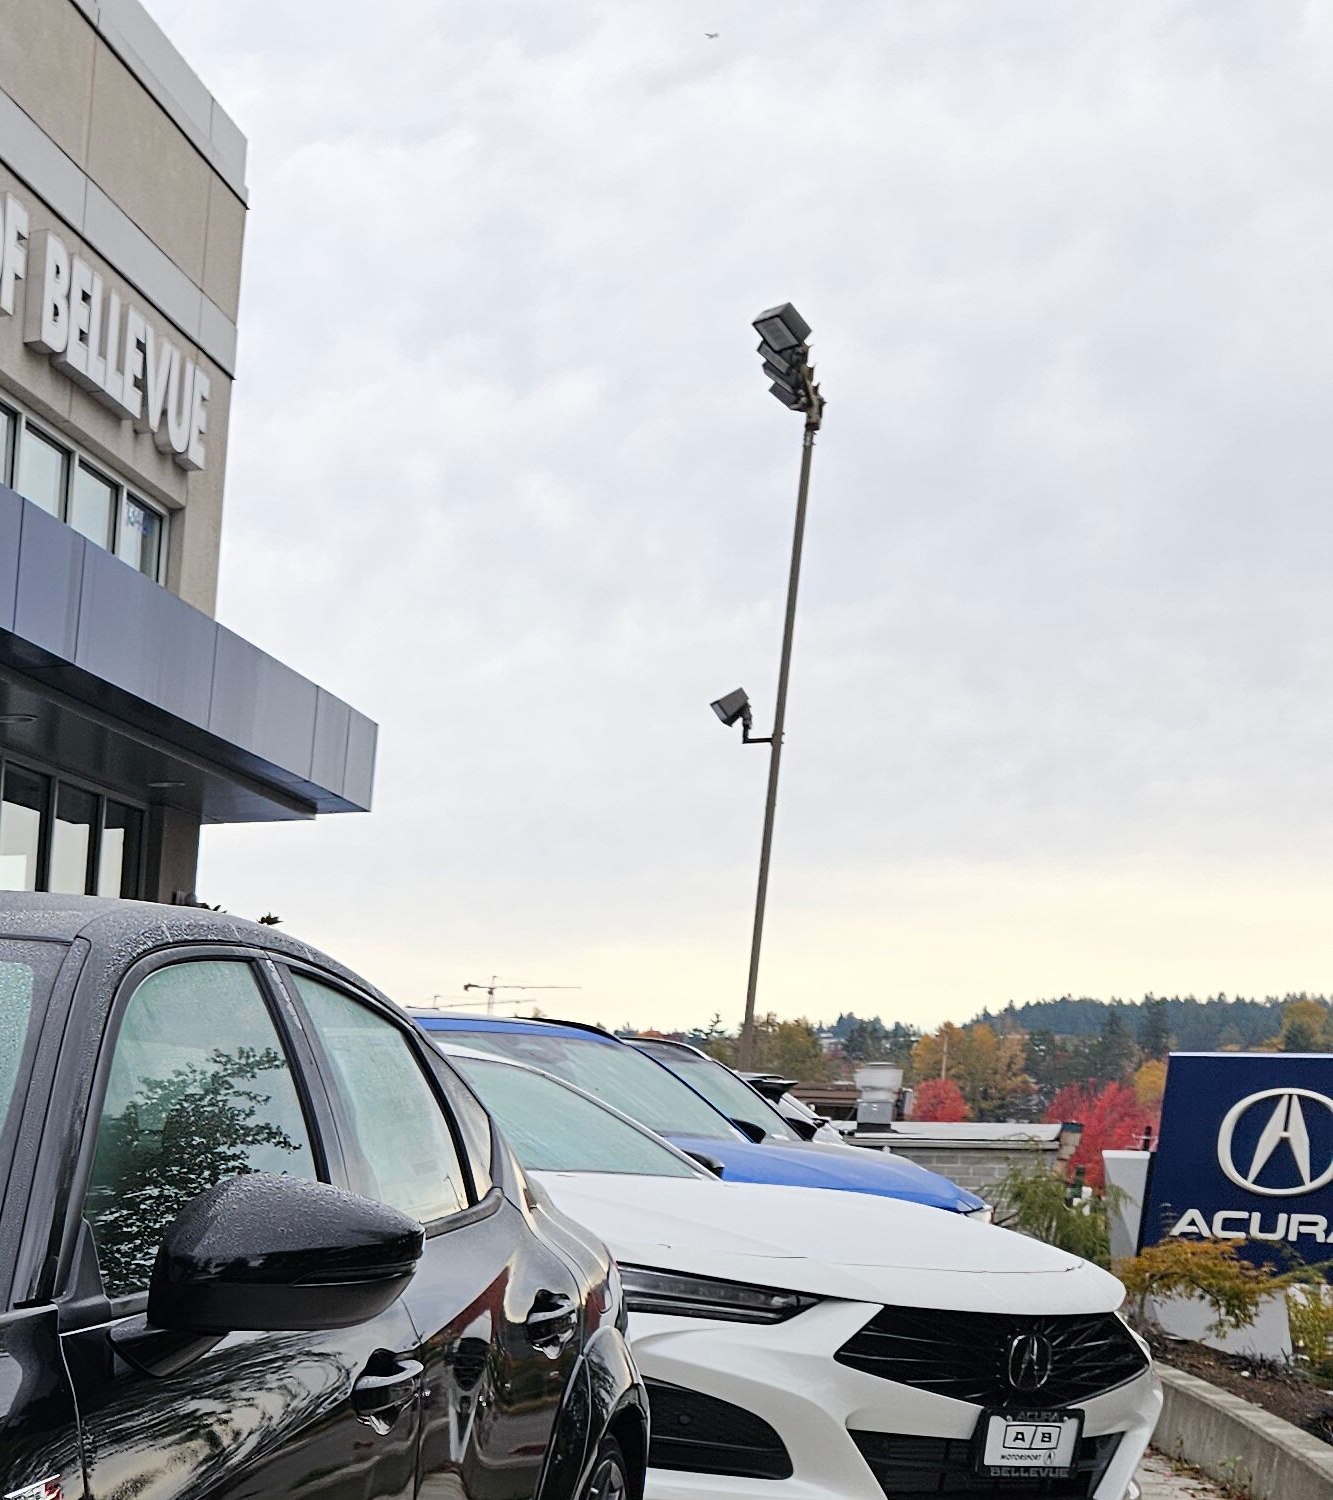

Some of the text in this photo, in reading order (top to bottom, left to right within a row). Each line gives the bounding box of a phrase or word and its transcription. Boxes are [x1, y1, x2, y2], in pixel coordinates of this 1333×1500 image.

[31, 229, 212, 471] BELLEVUE
[1169, 1208, 1333, 1244] ACUR
[1016, 1411, 1061, 1422] ACURA
[1012, 1431, 1026, 1443] A
[990, 1466, 1070, 1478] BELLEVUE
